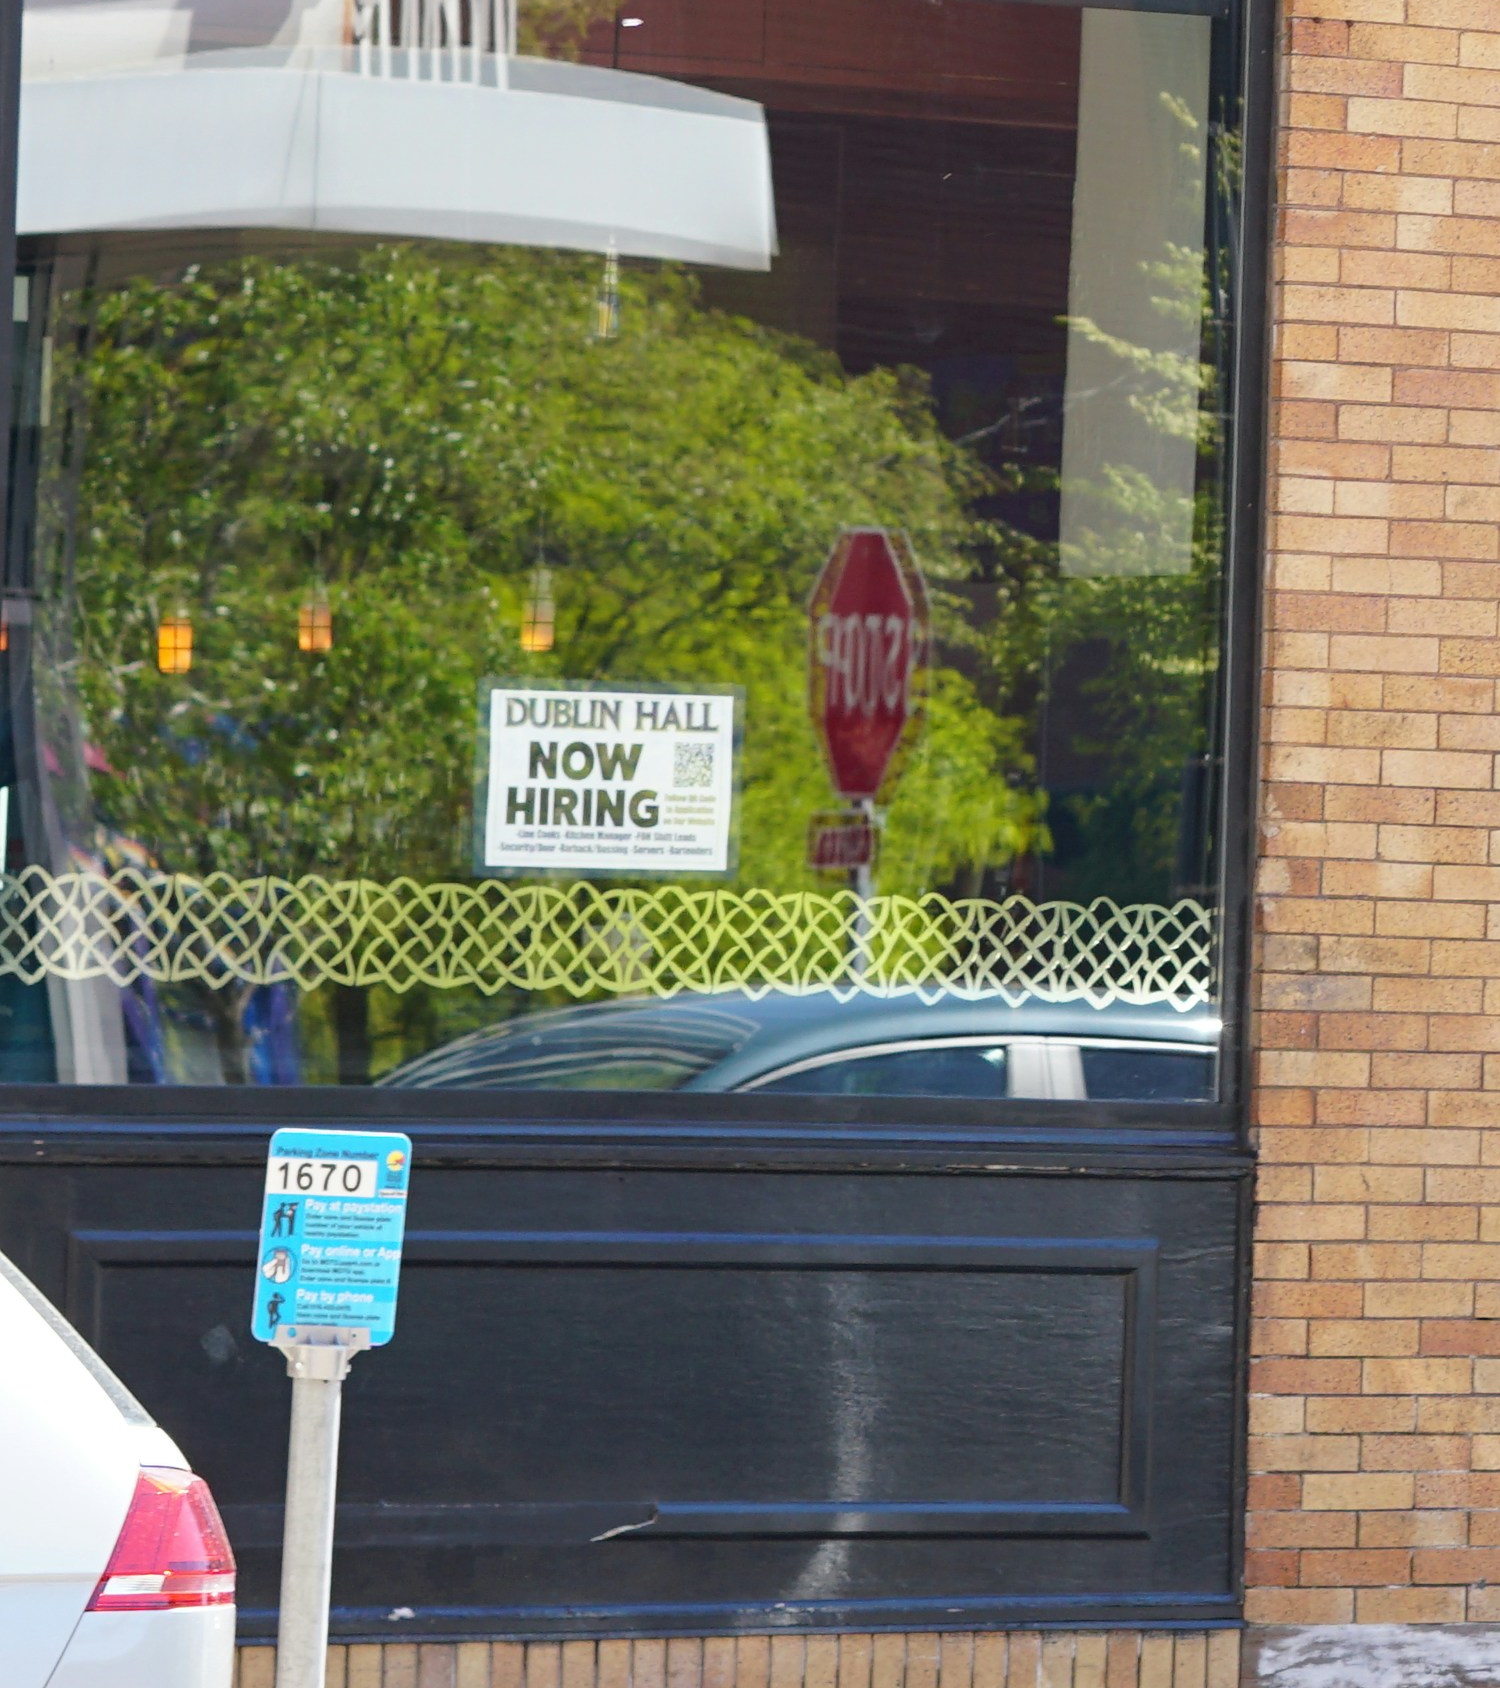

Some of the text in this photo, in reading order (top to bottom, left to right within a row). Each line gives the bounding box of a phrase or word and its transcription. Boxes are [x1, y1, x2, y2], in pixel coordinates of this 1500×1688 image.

[506, 697, 719, 732] DUBLIN HALL
[529, 740, 644, 781] NOW
[506, 787, 660, 828] HIRING
[277, 1146, 379, 1160] Parking Zone Number
[279, 1162, 362, 1192] 1670
[305, 1199, 402, 1215] Pay at paystation
[301, 1243, 402, 1261] Pay online or App
[296, 1288, 374, 1305] Pay by phone
